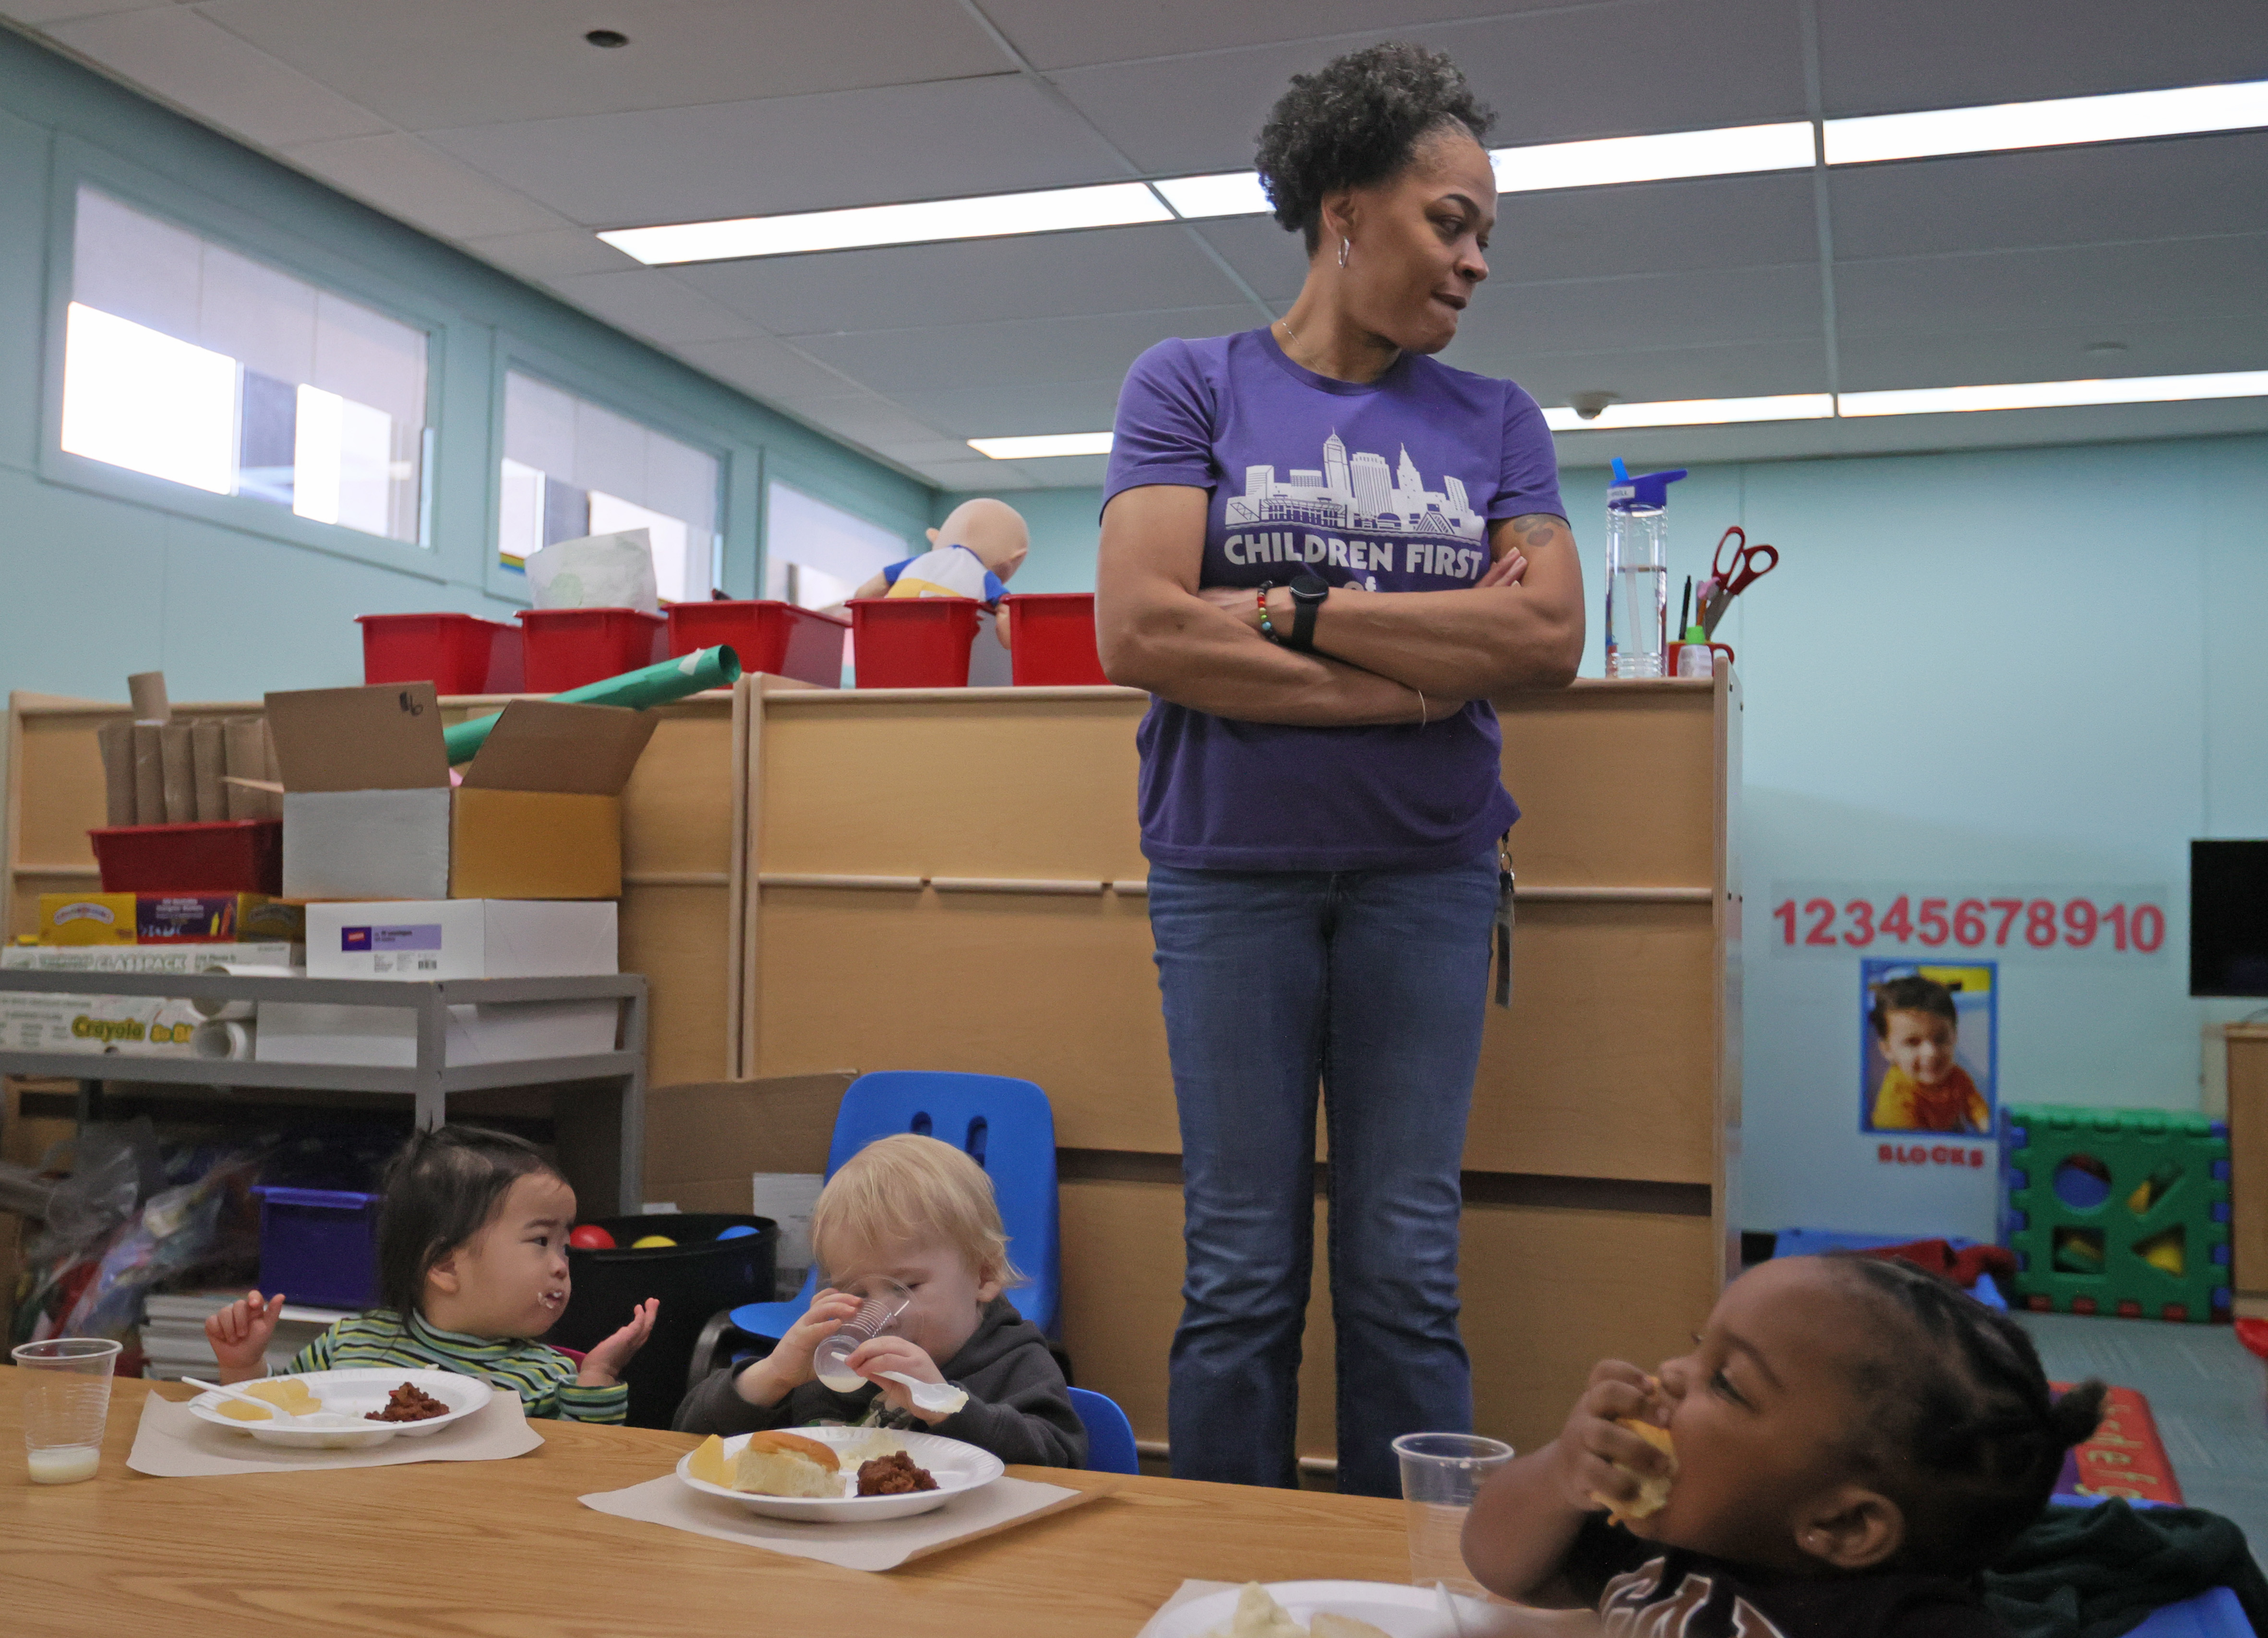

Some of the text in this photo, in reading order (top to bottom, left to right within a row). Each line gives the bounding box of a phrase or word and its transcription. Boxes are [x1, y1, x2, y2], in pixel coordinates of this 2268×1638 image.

[1224, 532, 1483, 580] CHILDREN FIRST
[72, 1014, 145, 1043] Crayola
[1878, 1144, 1984, 1168] BLOCKS
